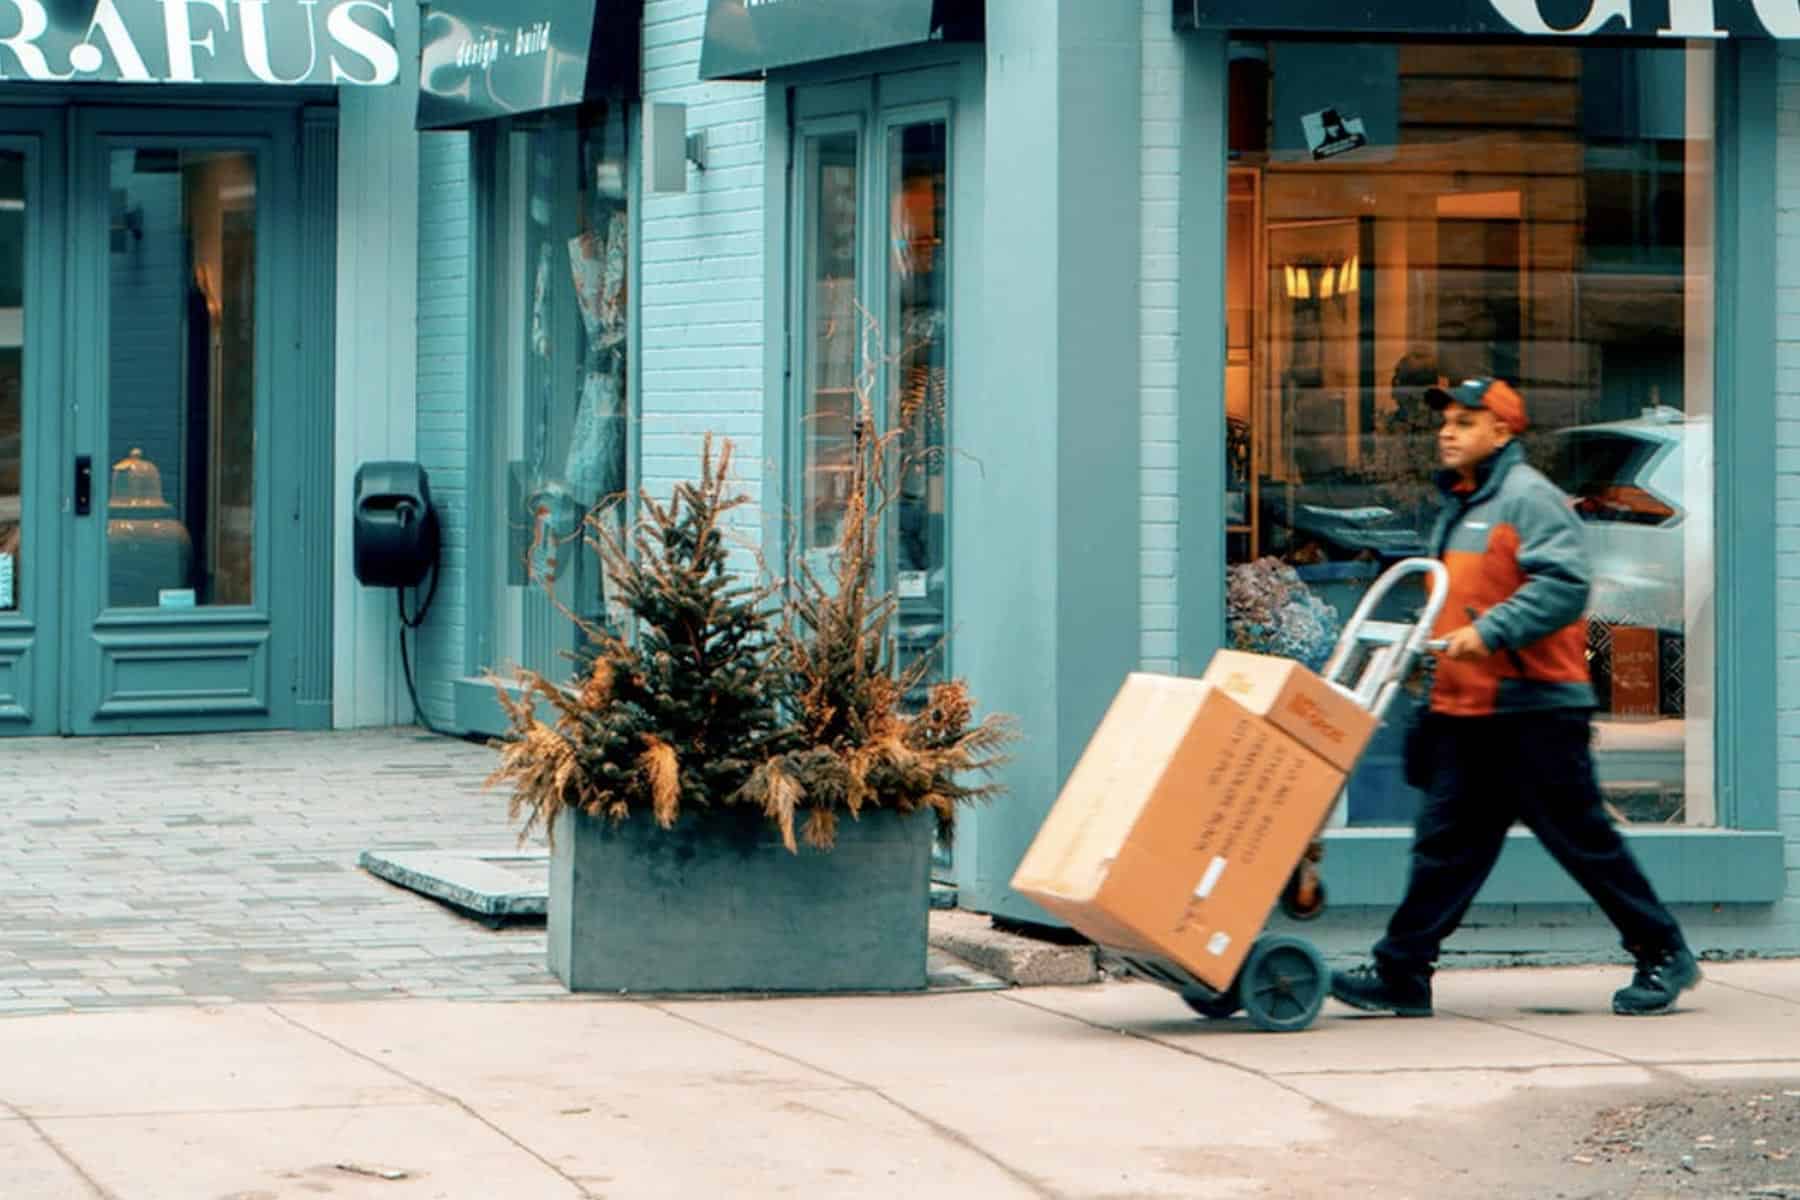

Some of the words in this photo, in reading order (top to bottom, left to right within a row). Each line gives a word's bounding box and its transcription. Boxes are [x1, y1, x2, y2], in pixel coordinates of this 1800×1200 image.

[0, 0, 400, 85] RAFUS
[456, 35, 498, 70] design
[515, 21, 551, 56] build
